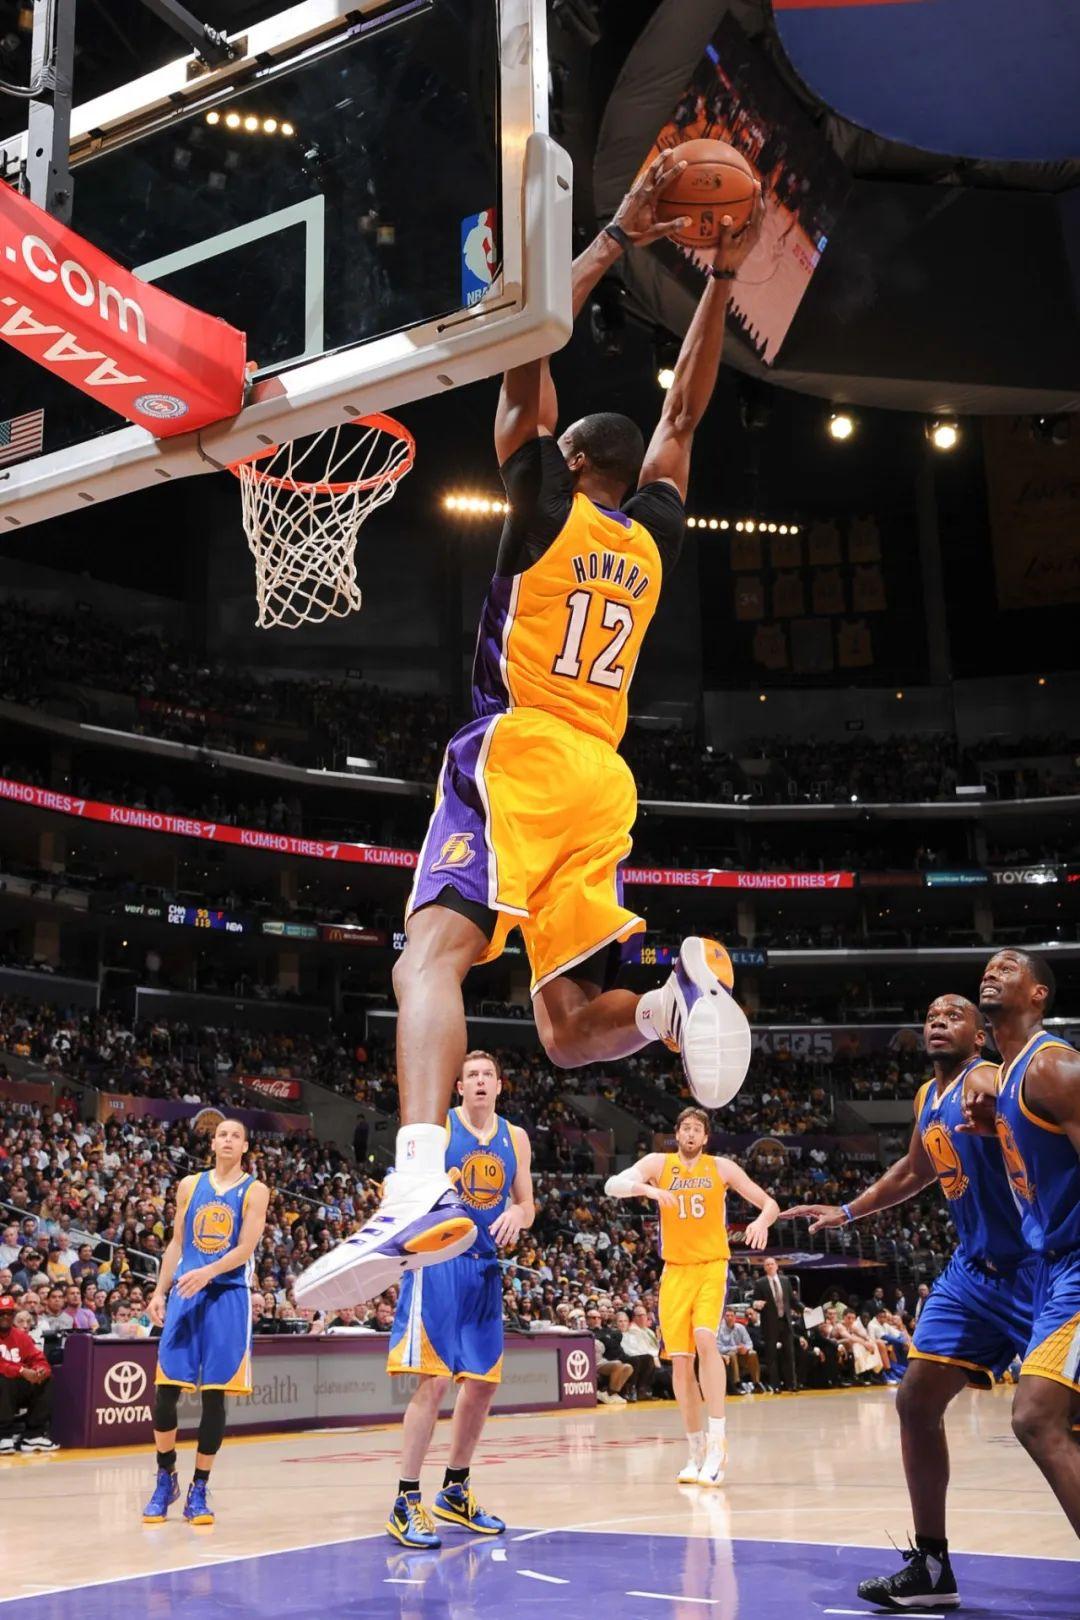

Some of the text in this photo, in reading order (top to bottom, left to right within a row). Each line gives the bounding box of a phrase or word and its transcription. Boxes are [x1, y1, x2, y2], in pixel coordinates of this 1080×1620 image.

[5, 234, 147, 345] .com
[572, 552, 650, 600] HOWARD
[551, 589, 634, 692] 12
[0, 779, 72, 812] MHO TIRES
[110, 807, 202, 836] KUMHO TIRES
[241, 829, 325, 857] KUMHO TIRES
[364, 848, 414, 866] KUMHO
[622, 869, 700, 885] UMHO TIRES
[738, 874, 826, 888] KUMHO TIRES
[124, 903, 161, 917] verion
[732, 951, 765, 963] ELTA
[750, 1033, 833, 1056] KERS
[484, 1164, 497, 1177] 10
[668, 1176, 713, 1191] LAKERS
[677, 1193, 706, 1220] 16
[212, 1211, 226, 1223] 30
[563, 1382, 594, 1396] TOYOTA
[96, 1405, 153, 1425] TOYOTA
